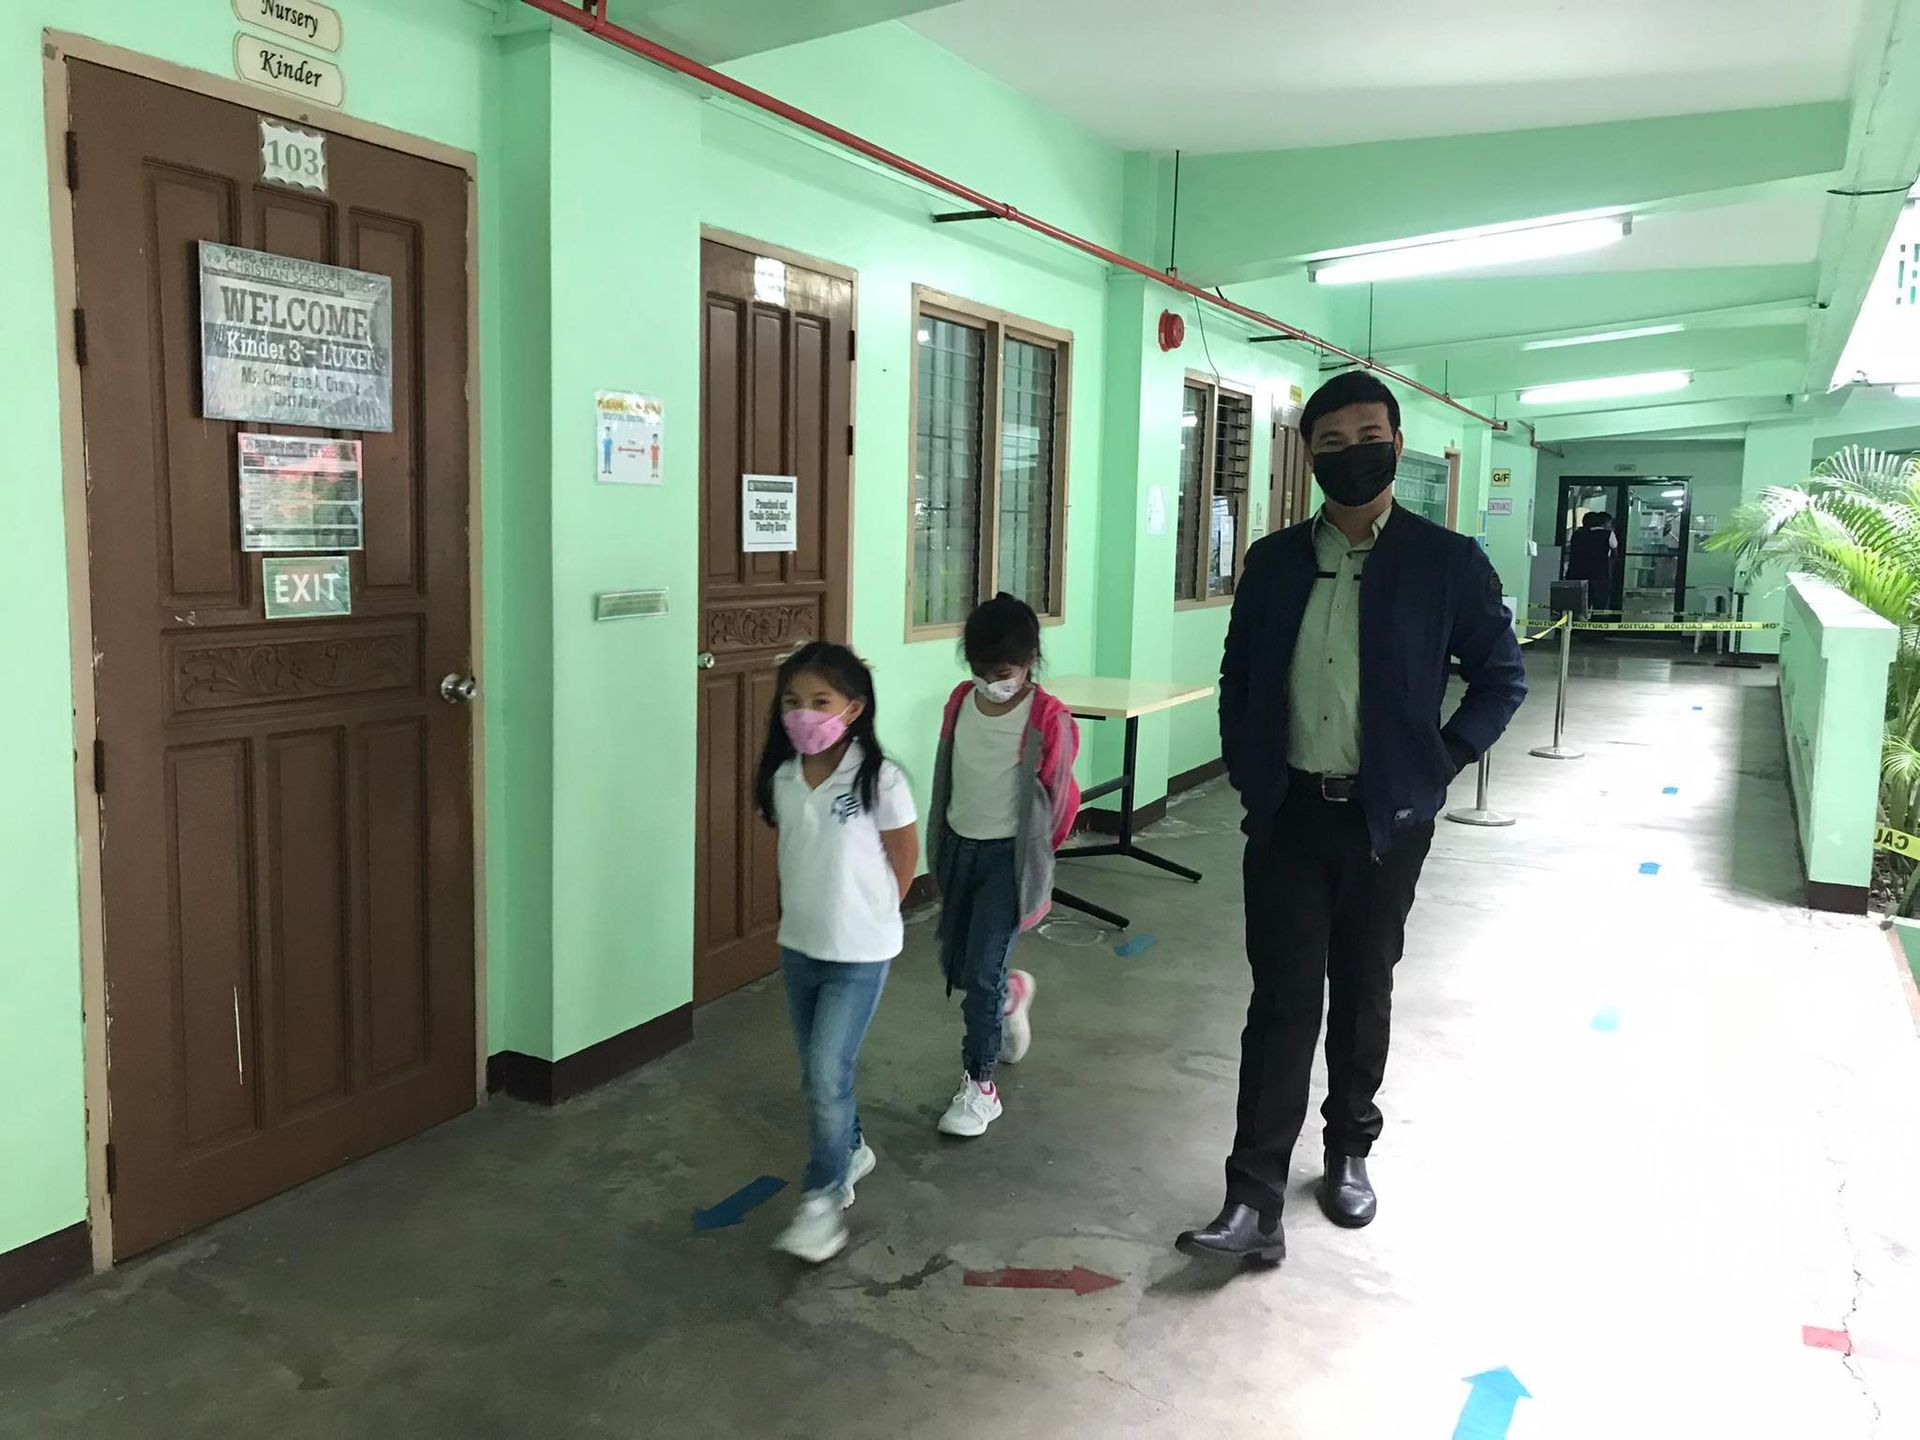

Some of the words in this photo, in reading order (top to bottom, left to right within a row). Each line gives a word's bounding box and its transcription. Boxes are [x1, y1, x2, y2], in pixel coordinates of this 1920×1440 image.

[261, 0, 319, 38] Nursery
[260, 50, 322, 87] Kinder
[268, 140, 320, 177] 103
[226, 259, 290, 281] CHRISTIAN
[293, 270, 344, 290] SCHOOL
[260, 256, 296, 271] GREEN
[220, 285, 371, 343] WELCOME
[226, 331, 285, 360] Kinder
[289, 339, 302, 362] 3
[1493, 473, 1510, 483] G/F
[274, 573, 340, 603] EXIT
